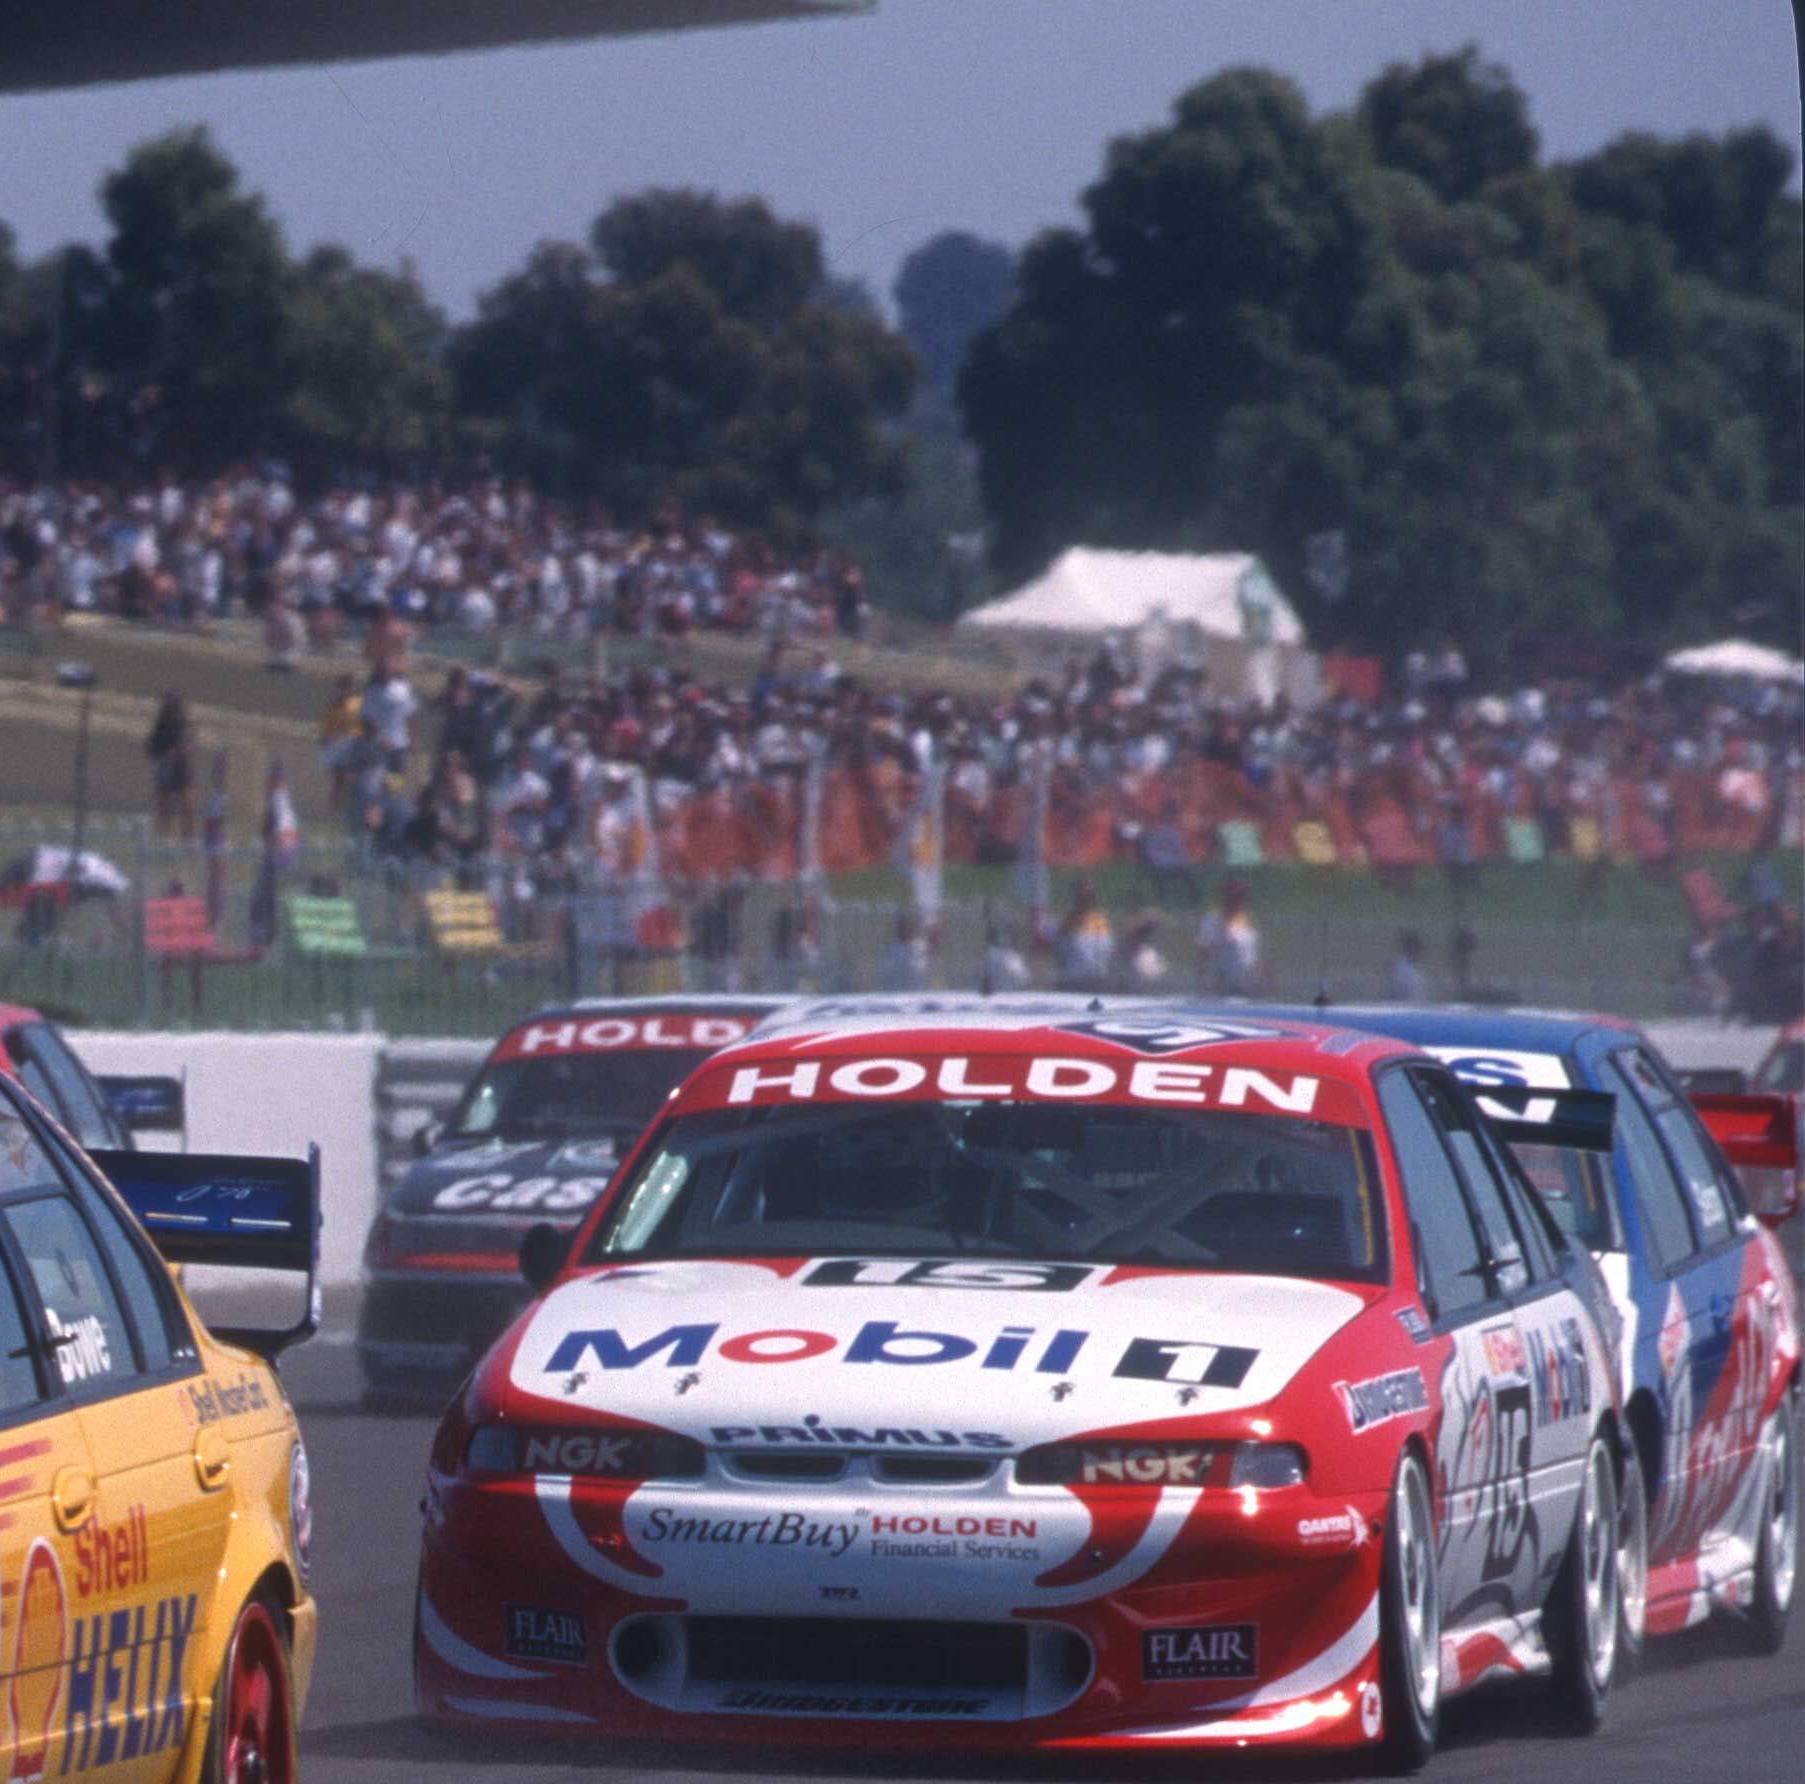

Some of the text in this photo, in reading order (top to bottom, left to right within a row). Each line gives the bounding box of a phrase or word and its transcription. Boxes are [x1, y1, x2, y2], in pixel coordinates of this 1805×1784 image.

[521, 1018, 744, 1052] HOLD
[728, 1057, 1319, 1114] HOLDEN
[545, 1321, 1219, 1384] Mobil 1
[524, 1435, 632, 1470] NGK
[1083, 1449, 1201, 1482] NGK
[71, 1504, 148, 1598] Shell
[642, 1507, 1037, 1557] SmartBuy HOLDEN
[871, 1540, 1040, 1561] Financial Services
[515, 1609, 585, 1647] FLAIR
[1150, 1630, 1249, 1664] FLAIR
[61, 1594, 199, 1778] HELIX
